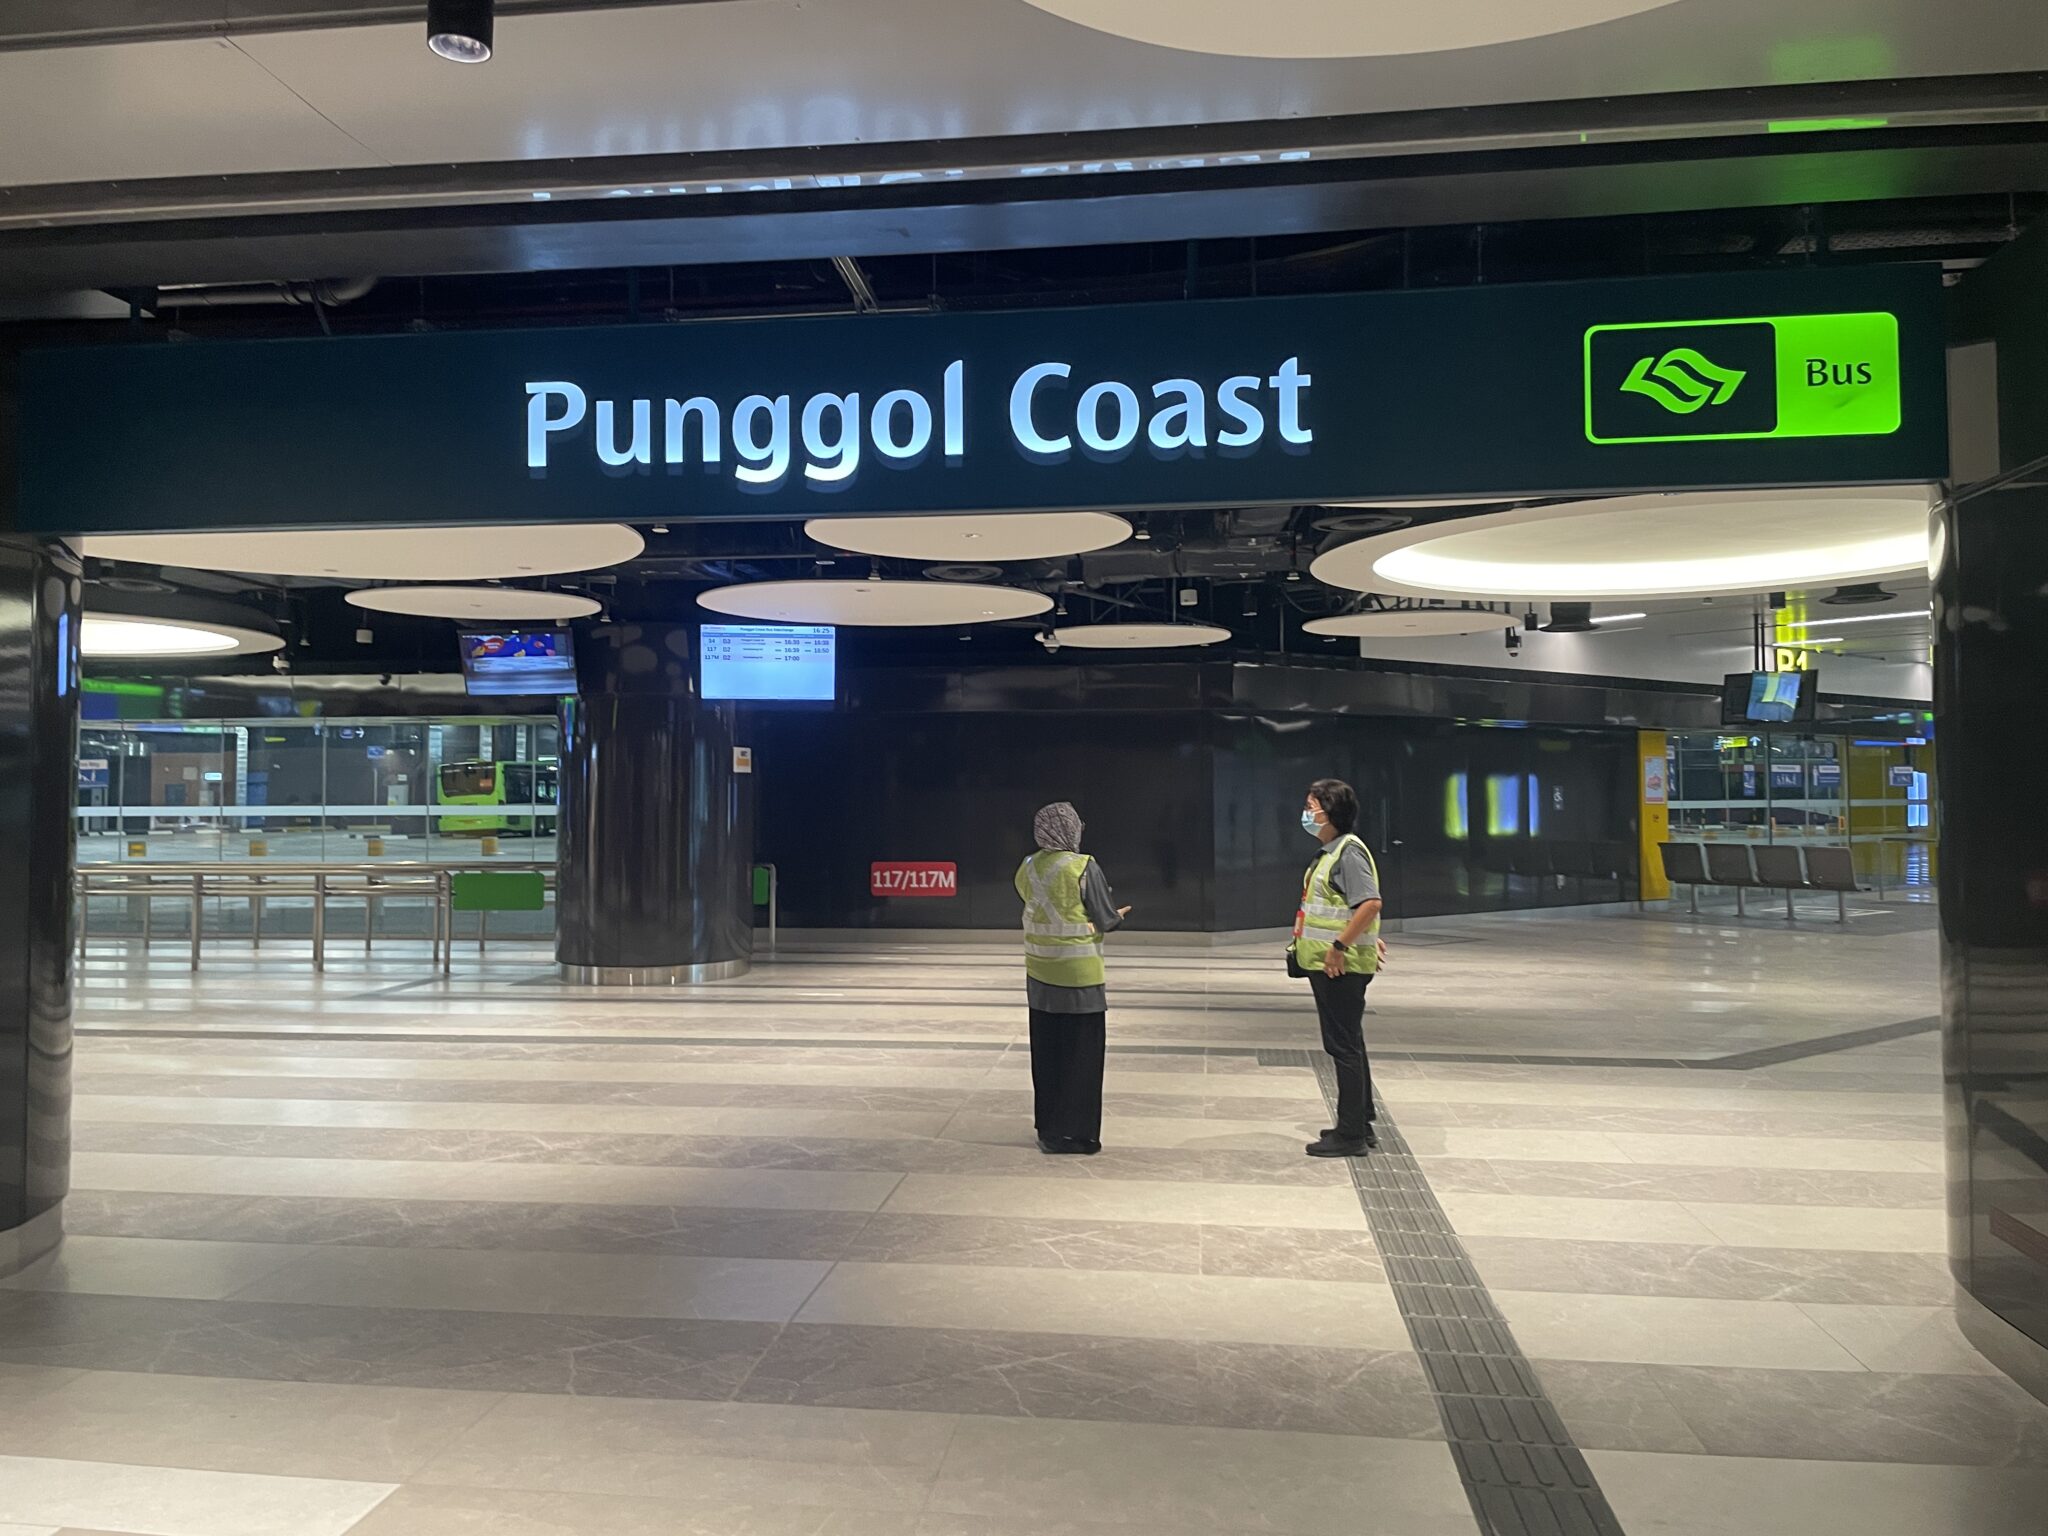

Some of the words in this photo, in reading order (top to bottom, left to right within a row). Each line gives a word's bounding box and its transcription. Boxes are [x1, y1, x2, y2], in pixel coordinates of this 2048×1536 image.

[1805, 358, 1872, 387] Bus
[525, 359, 964, 483] Punggol
[1009, 356, 1314, 454] Coast
[873, 870, 956, 890] 117/117M
